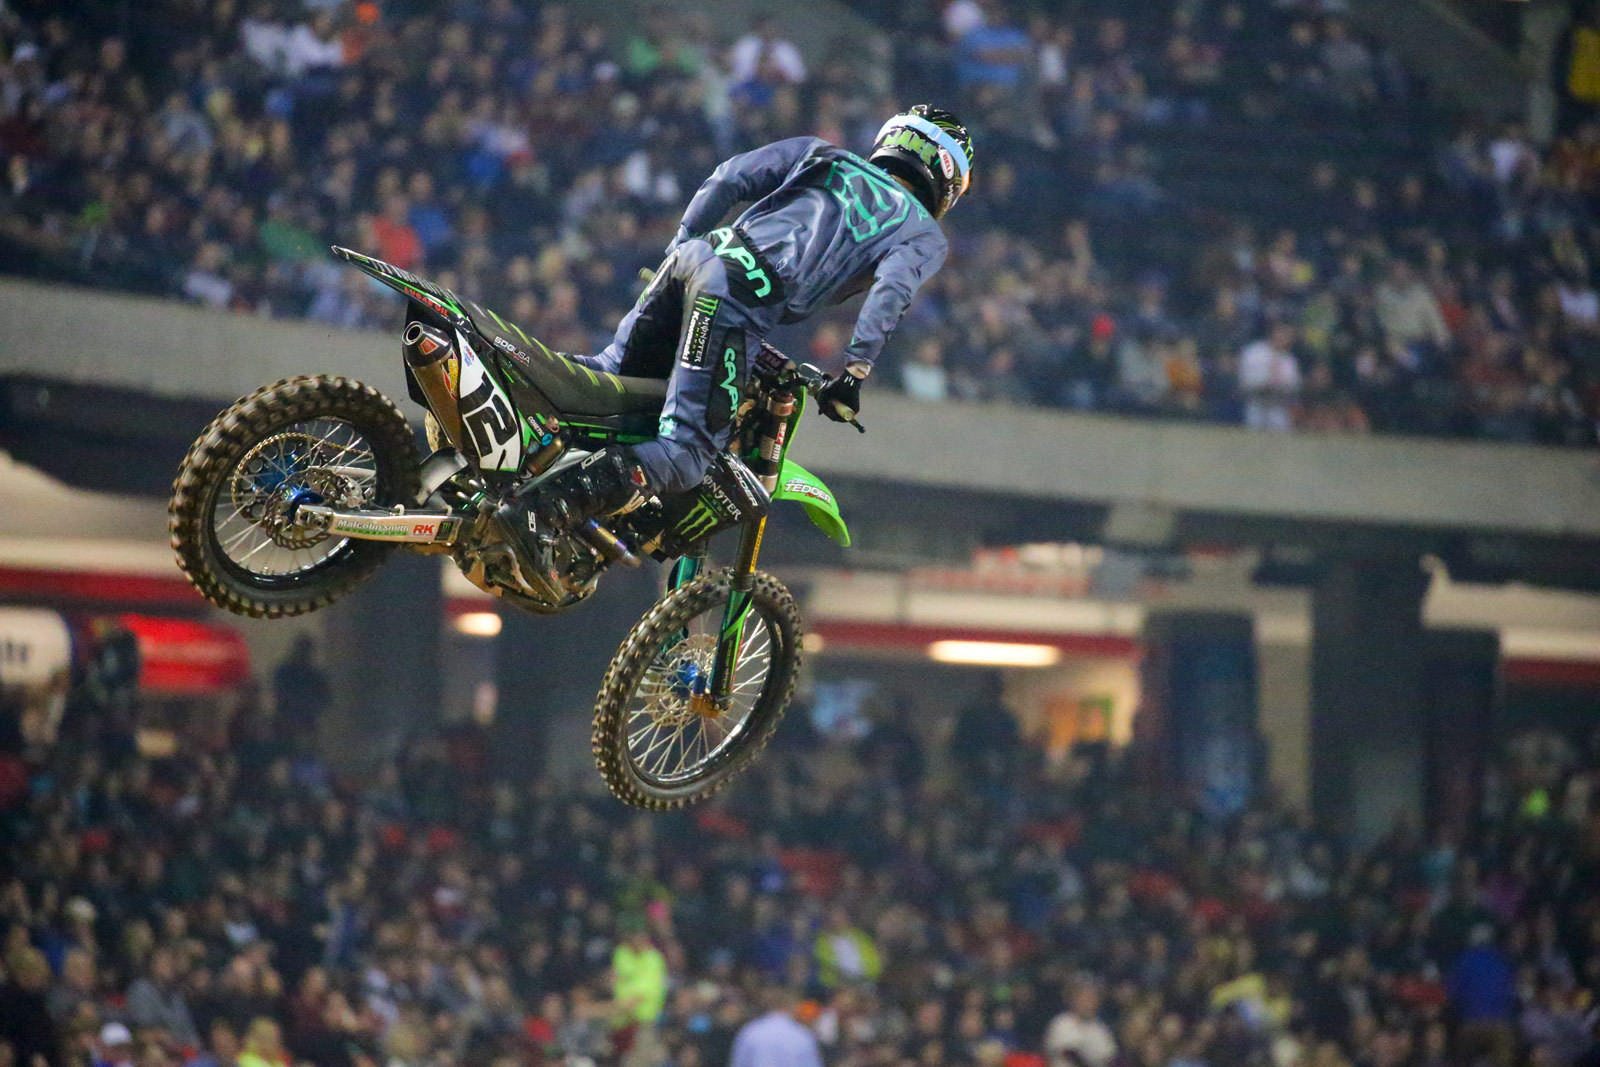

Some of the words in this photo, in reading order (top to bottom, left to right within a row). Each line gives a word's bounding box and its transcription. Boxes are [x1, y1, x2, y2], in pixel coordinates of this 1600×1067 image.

[682, 310, 700, 361] Kawasaki
[695, 316, 710, 363] MONSTER
[460, 371, 518, 458] 12
[702, 474, 741, 520] ONSTER
[784, 483, 831, 504] TEDDER
[413, 524, 435, 534] RK
